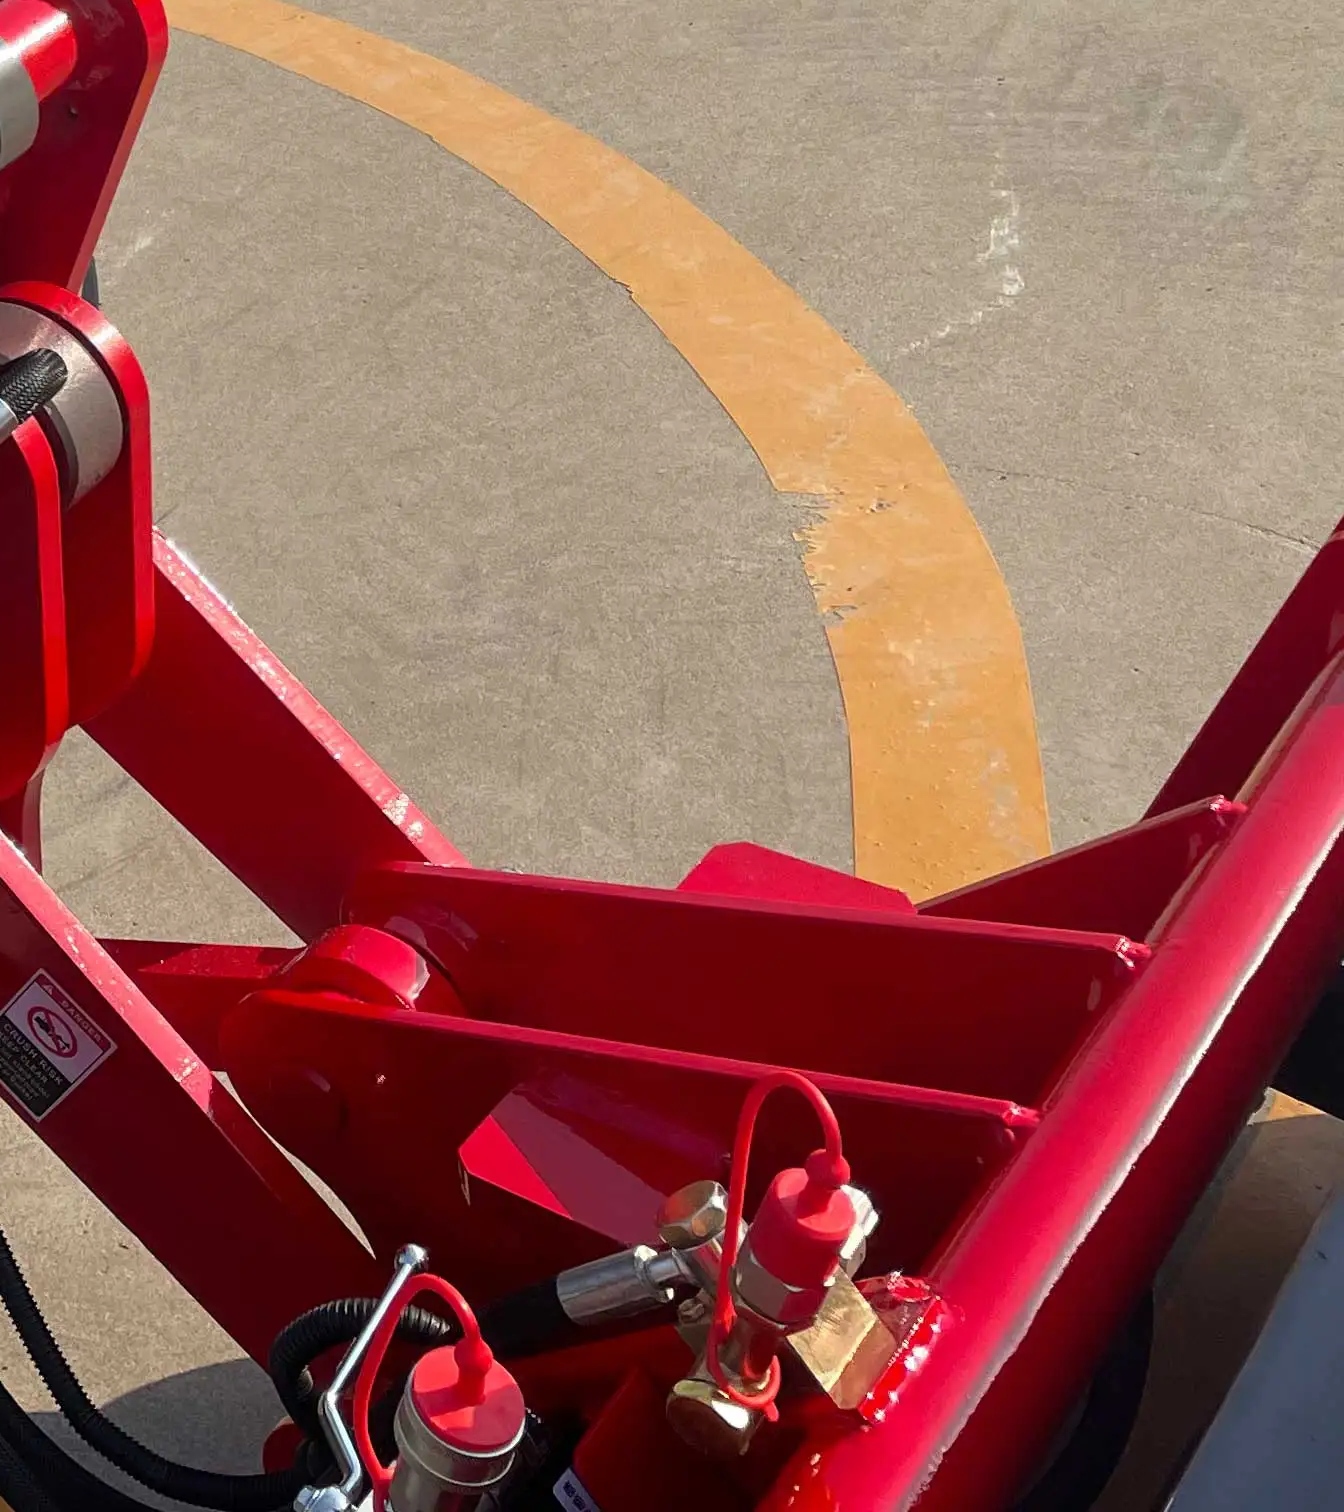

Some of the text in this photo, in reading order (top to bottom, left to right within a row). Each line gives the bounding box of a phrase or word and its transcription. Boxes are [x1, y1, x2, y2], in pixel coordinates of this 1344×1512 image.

[59, 1000, 102, 1044] DANGER
[3, 1024, 39, 1059] CRUSH
[40, 1060, 65, 1085] RISK
